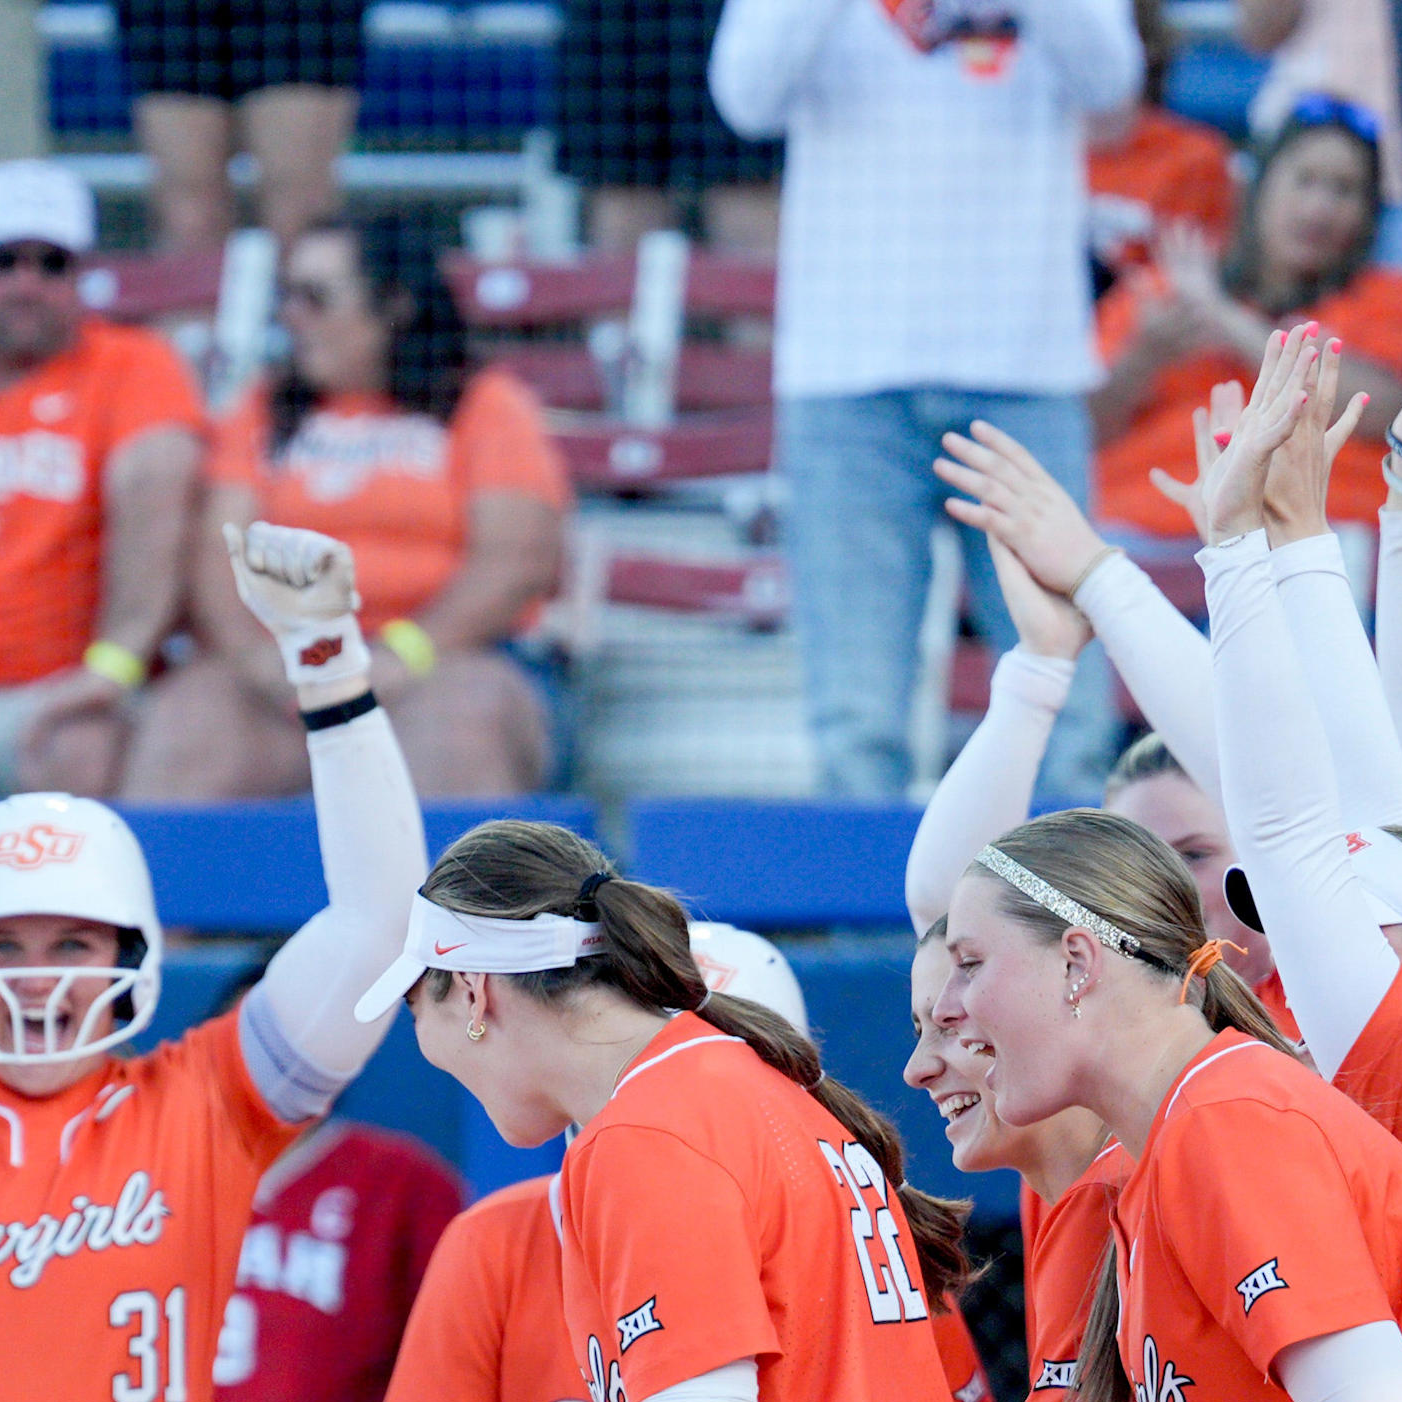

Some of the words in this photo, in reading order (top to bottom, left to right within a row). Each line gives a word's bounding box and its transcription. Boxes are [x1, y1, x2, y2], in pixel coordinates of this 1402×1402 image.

[817, 1138, 928, 1325] 22
[1235, 1256, 1291, 1317] XII
[617, 1295, 664, 1355] XII
